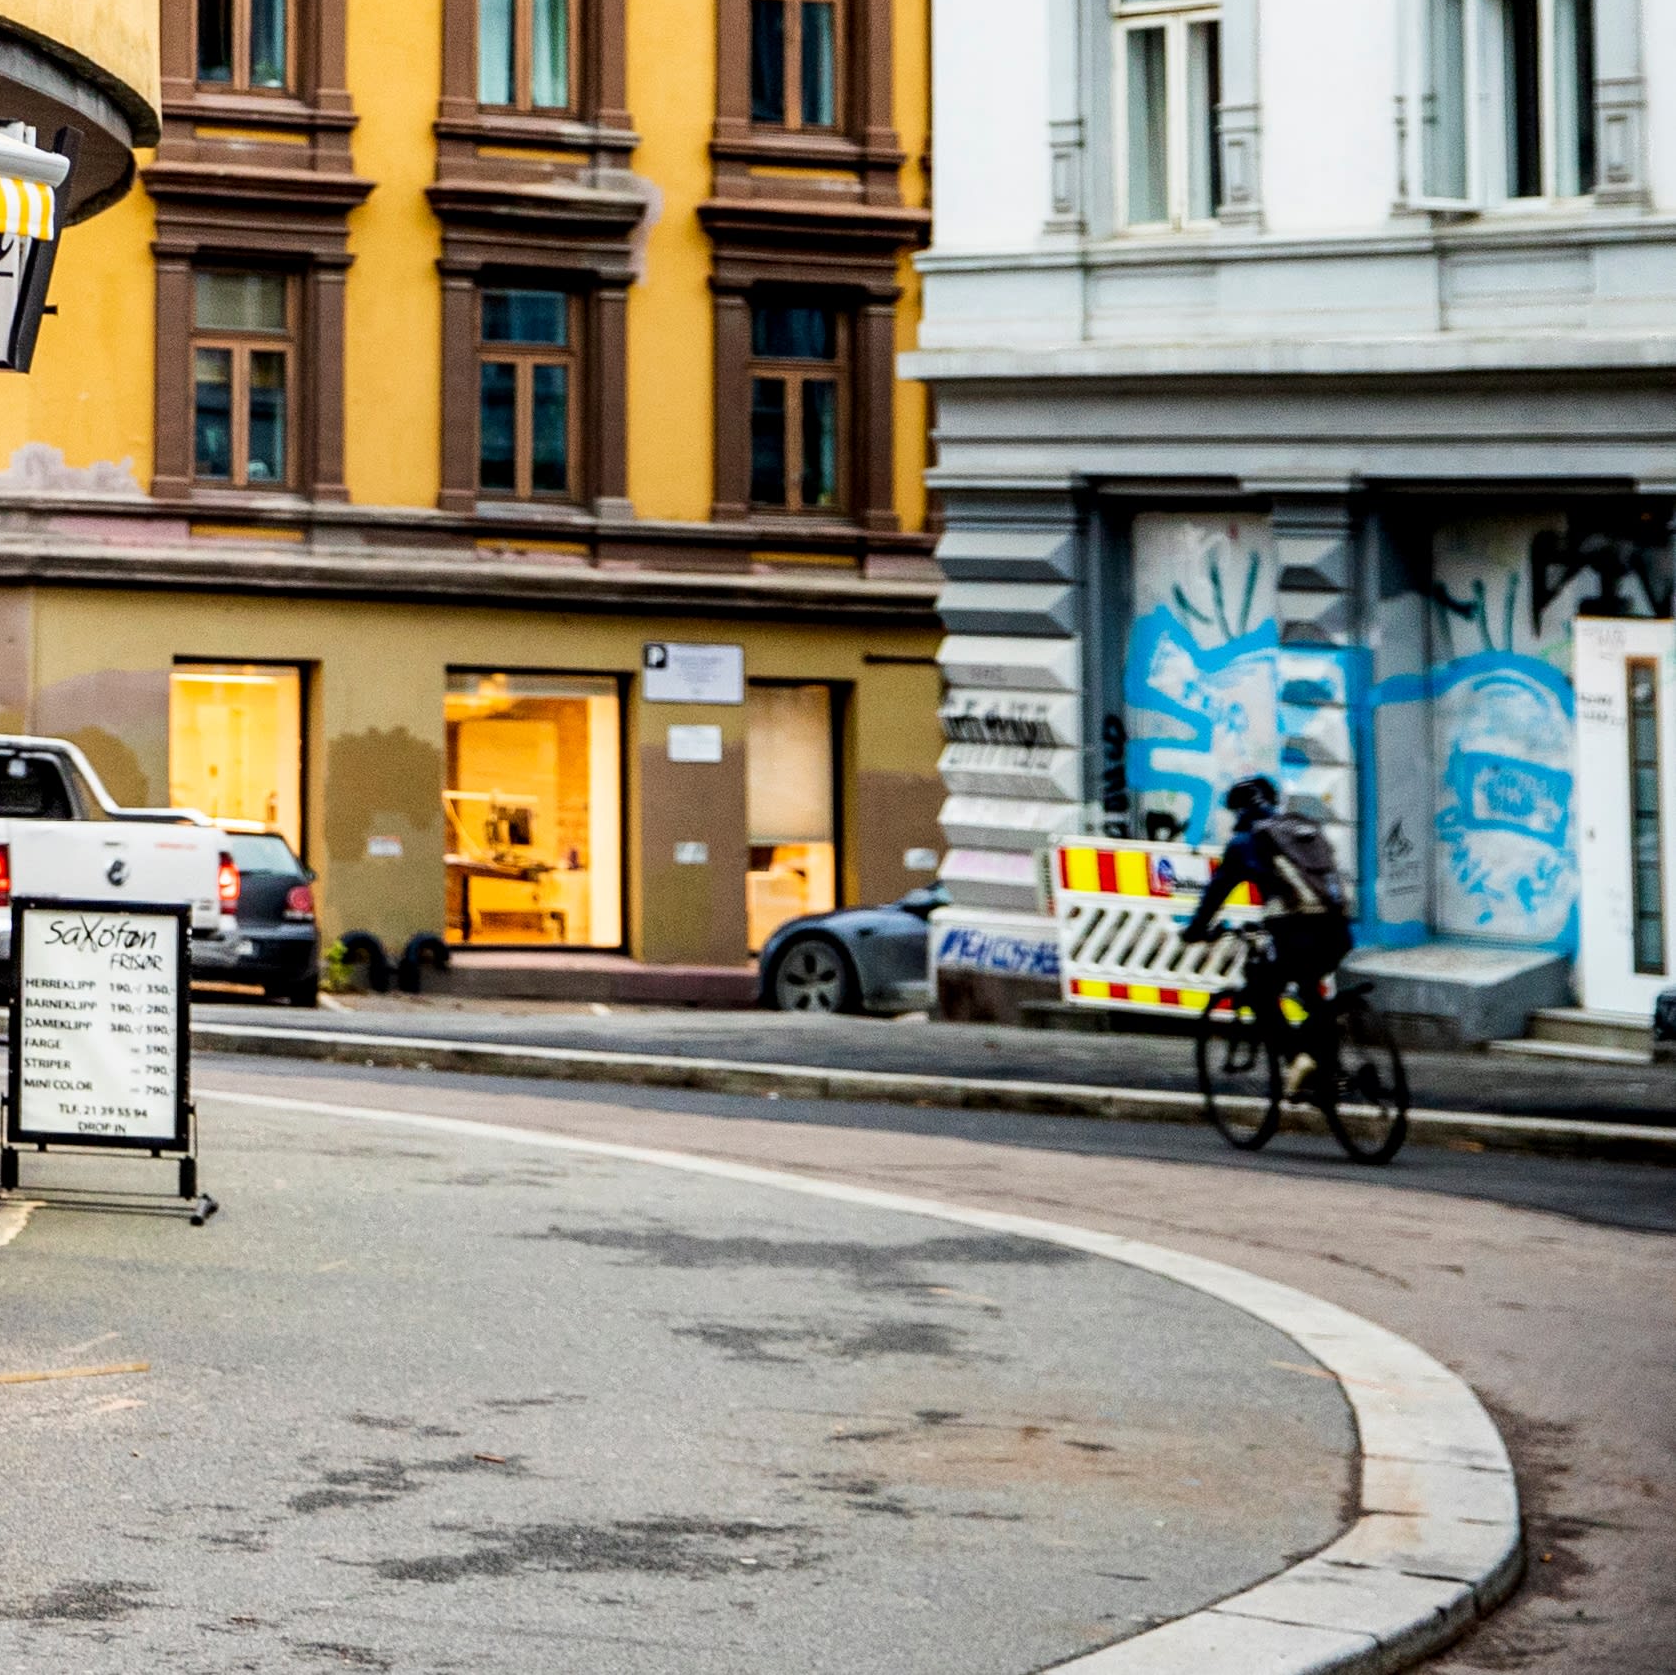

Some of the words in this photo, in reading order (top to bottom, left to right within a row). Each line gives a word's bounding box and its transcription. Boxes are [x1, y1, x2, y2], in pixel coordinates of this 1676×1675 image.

[25, 978, 96, 991] HERREKLIPP
[25, 998, 97, 1011] BARNEKLIPP
[24, 1017, 93, 1031] DAMEKLIPP
[24, 1037, 62, 1050] FARGE
[24, 1058, 72, 1071] STRIPER
[24, 1078, 51, 1089] MINI
[53, 1079, 93, 1092] COLOR
[77, 1120, 111, 1133] DROP
[115, 1123, 127, 1134] IN
